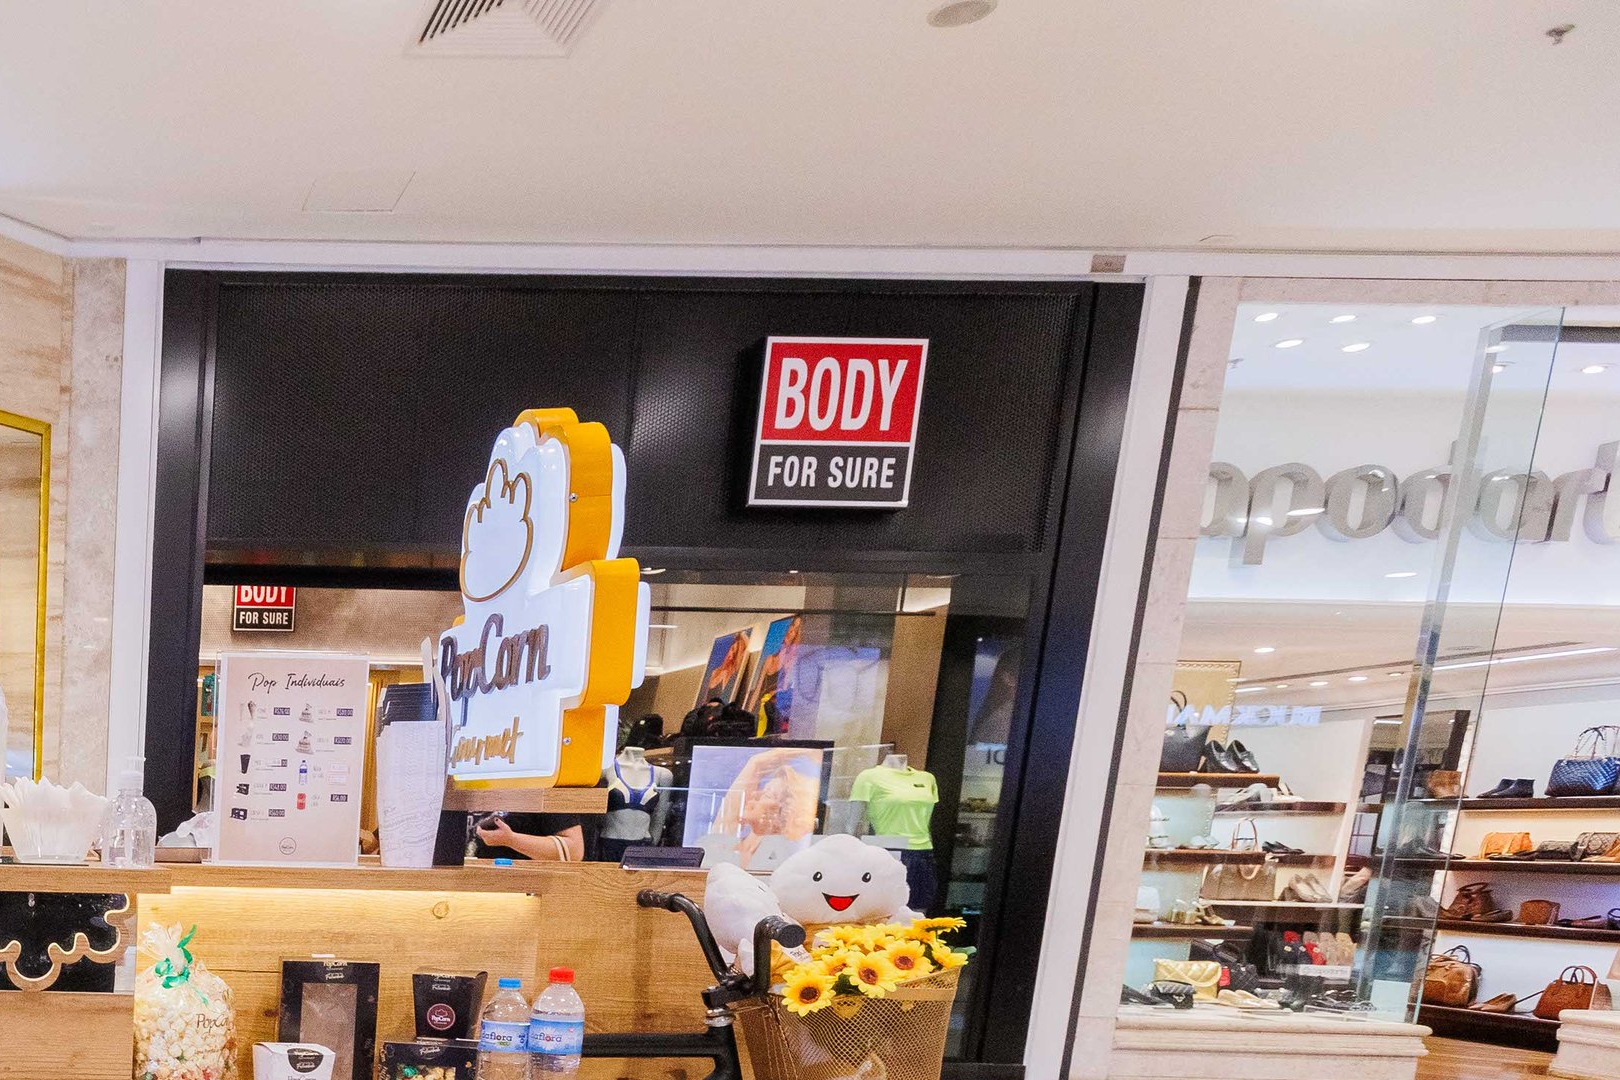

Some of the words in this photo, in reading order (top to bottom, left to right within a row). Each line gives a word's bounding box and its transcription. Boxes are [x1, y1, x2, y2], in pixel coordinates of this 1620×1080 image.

[774, 356, 909, 432] BODY
[767, 455, 818, 487] FOR
[827, 455, 897, 489] SURE
[239, 611, 259, 625] FOR
[262, 611, 289, 626] SURE
[247, 671, 277, 694] Pop
[284, 672, 346, 690] Individuais
